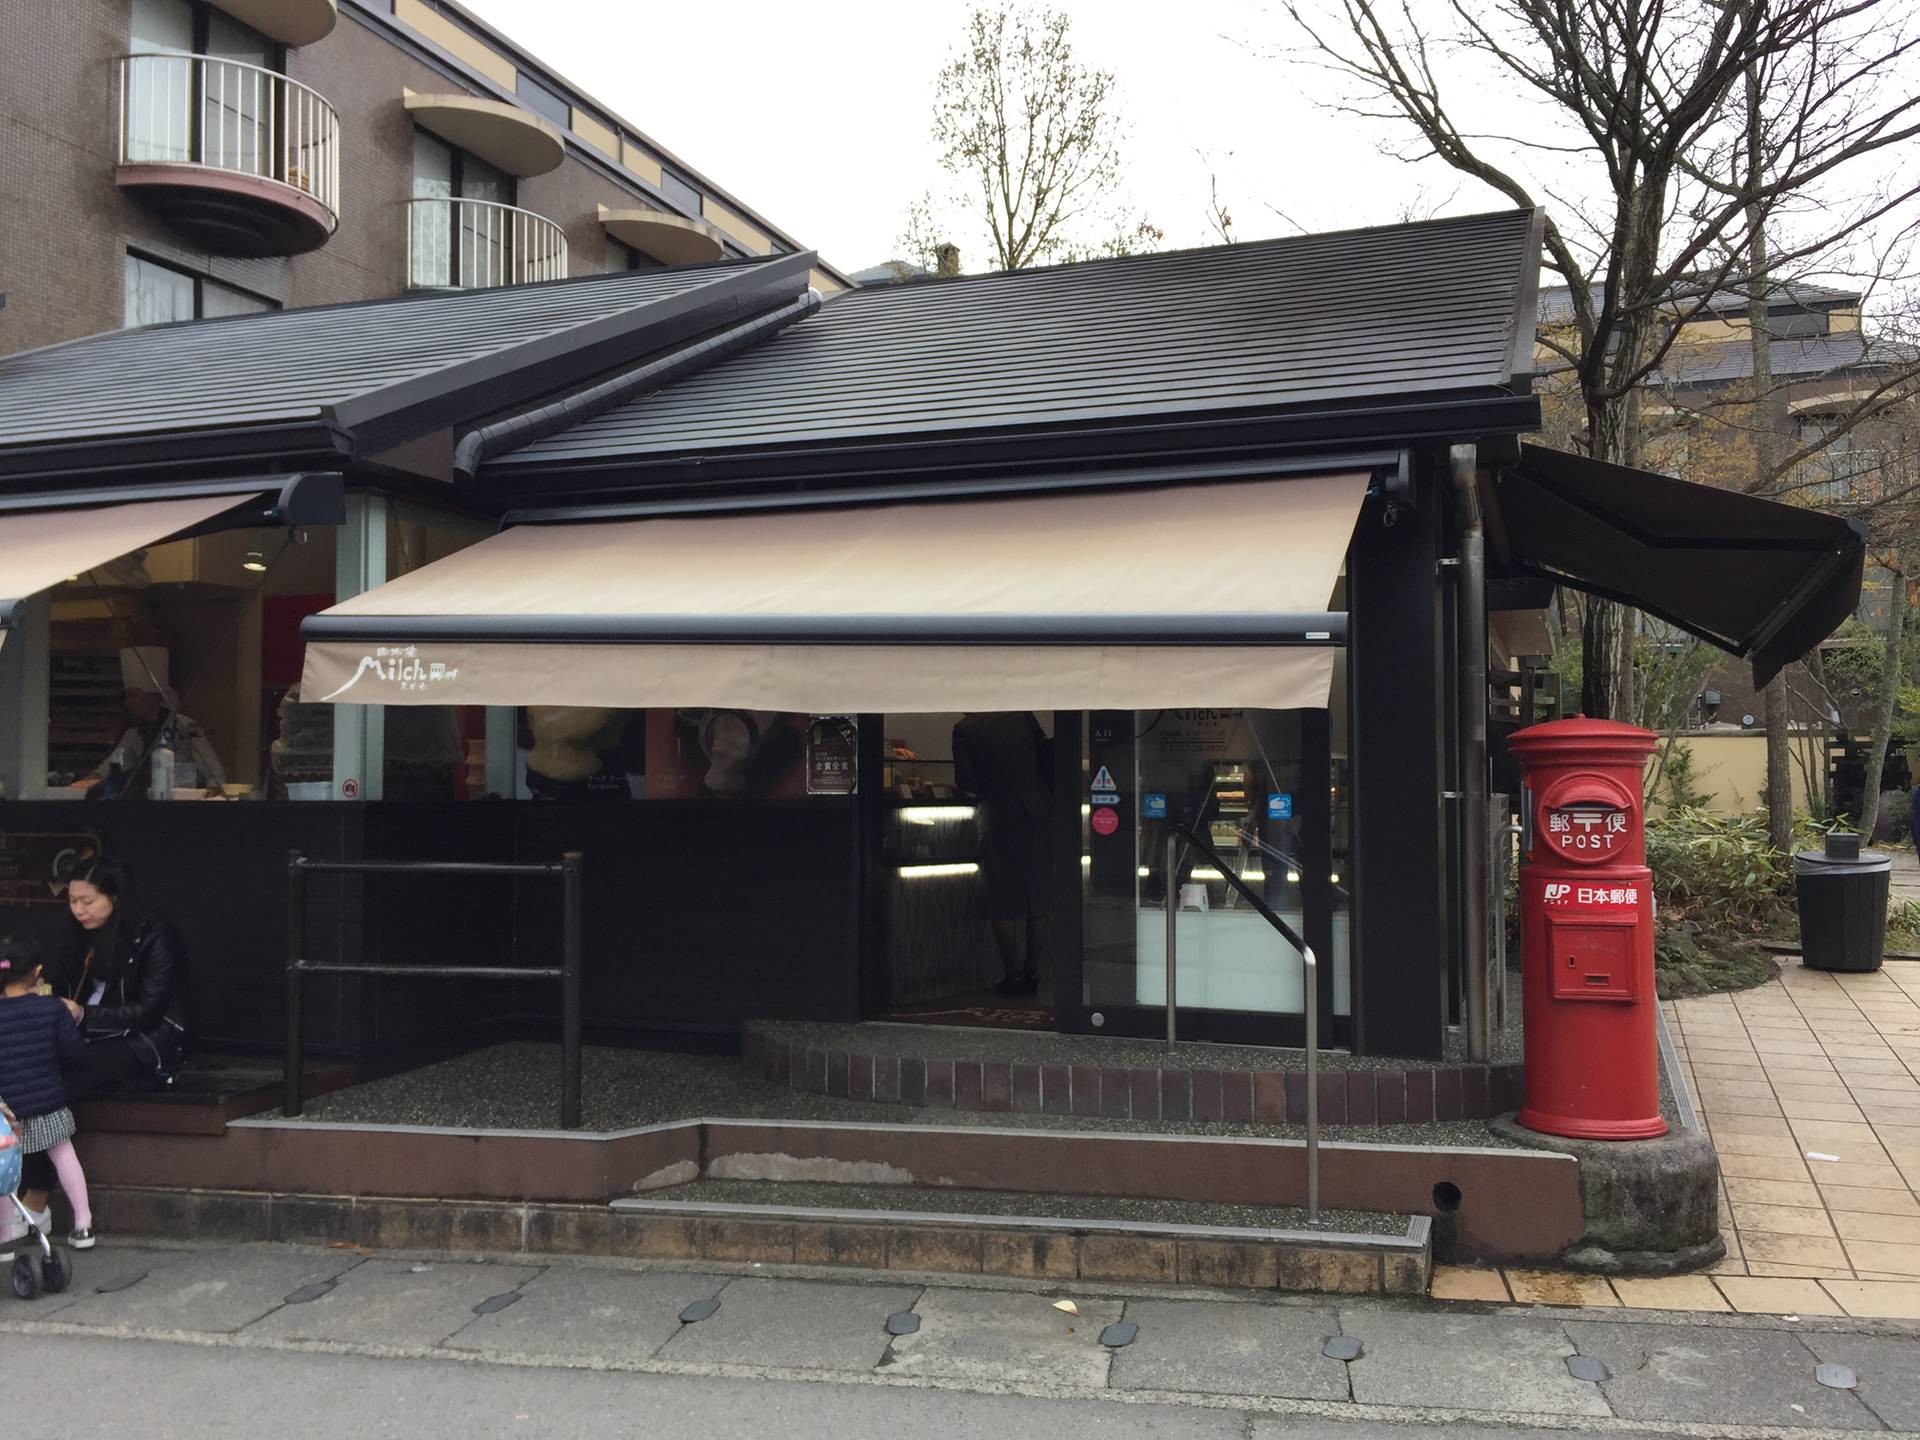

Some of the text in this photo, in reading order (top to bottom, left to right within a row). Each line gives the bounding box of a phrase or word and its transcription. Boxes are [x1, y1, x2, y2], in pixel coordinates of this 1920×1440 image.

[320, 656, 428, 701] Milch
[1561, 834, 1615, 849] POST
[1577, 888, 1638, 905] 日本郵便
